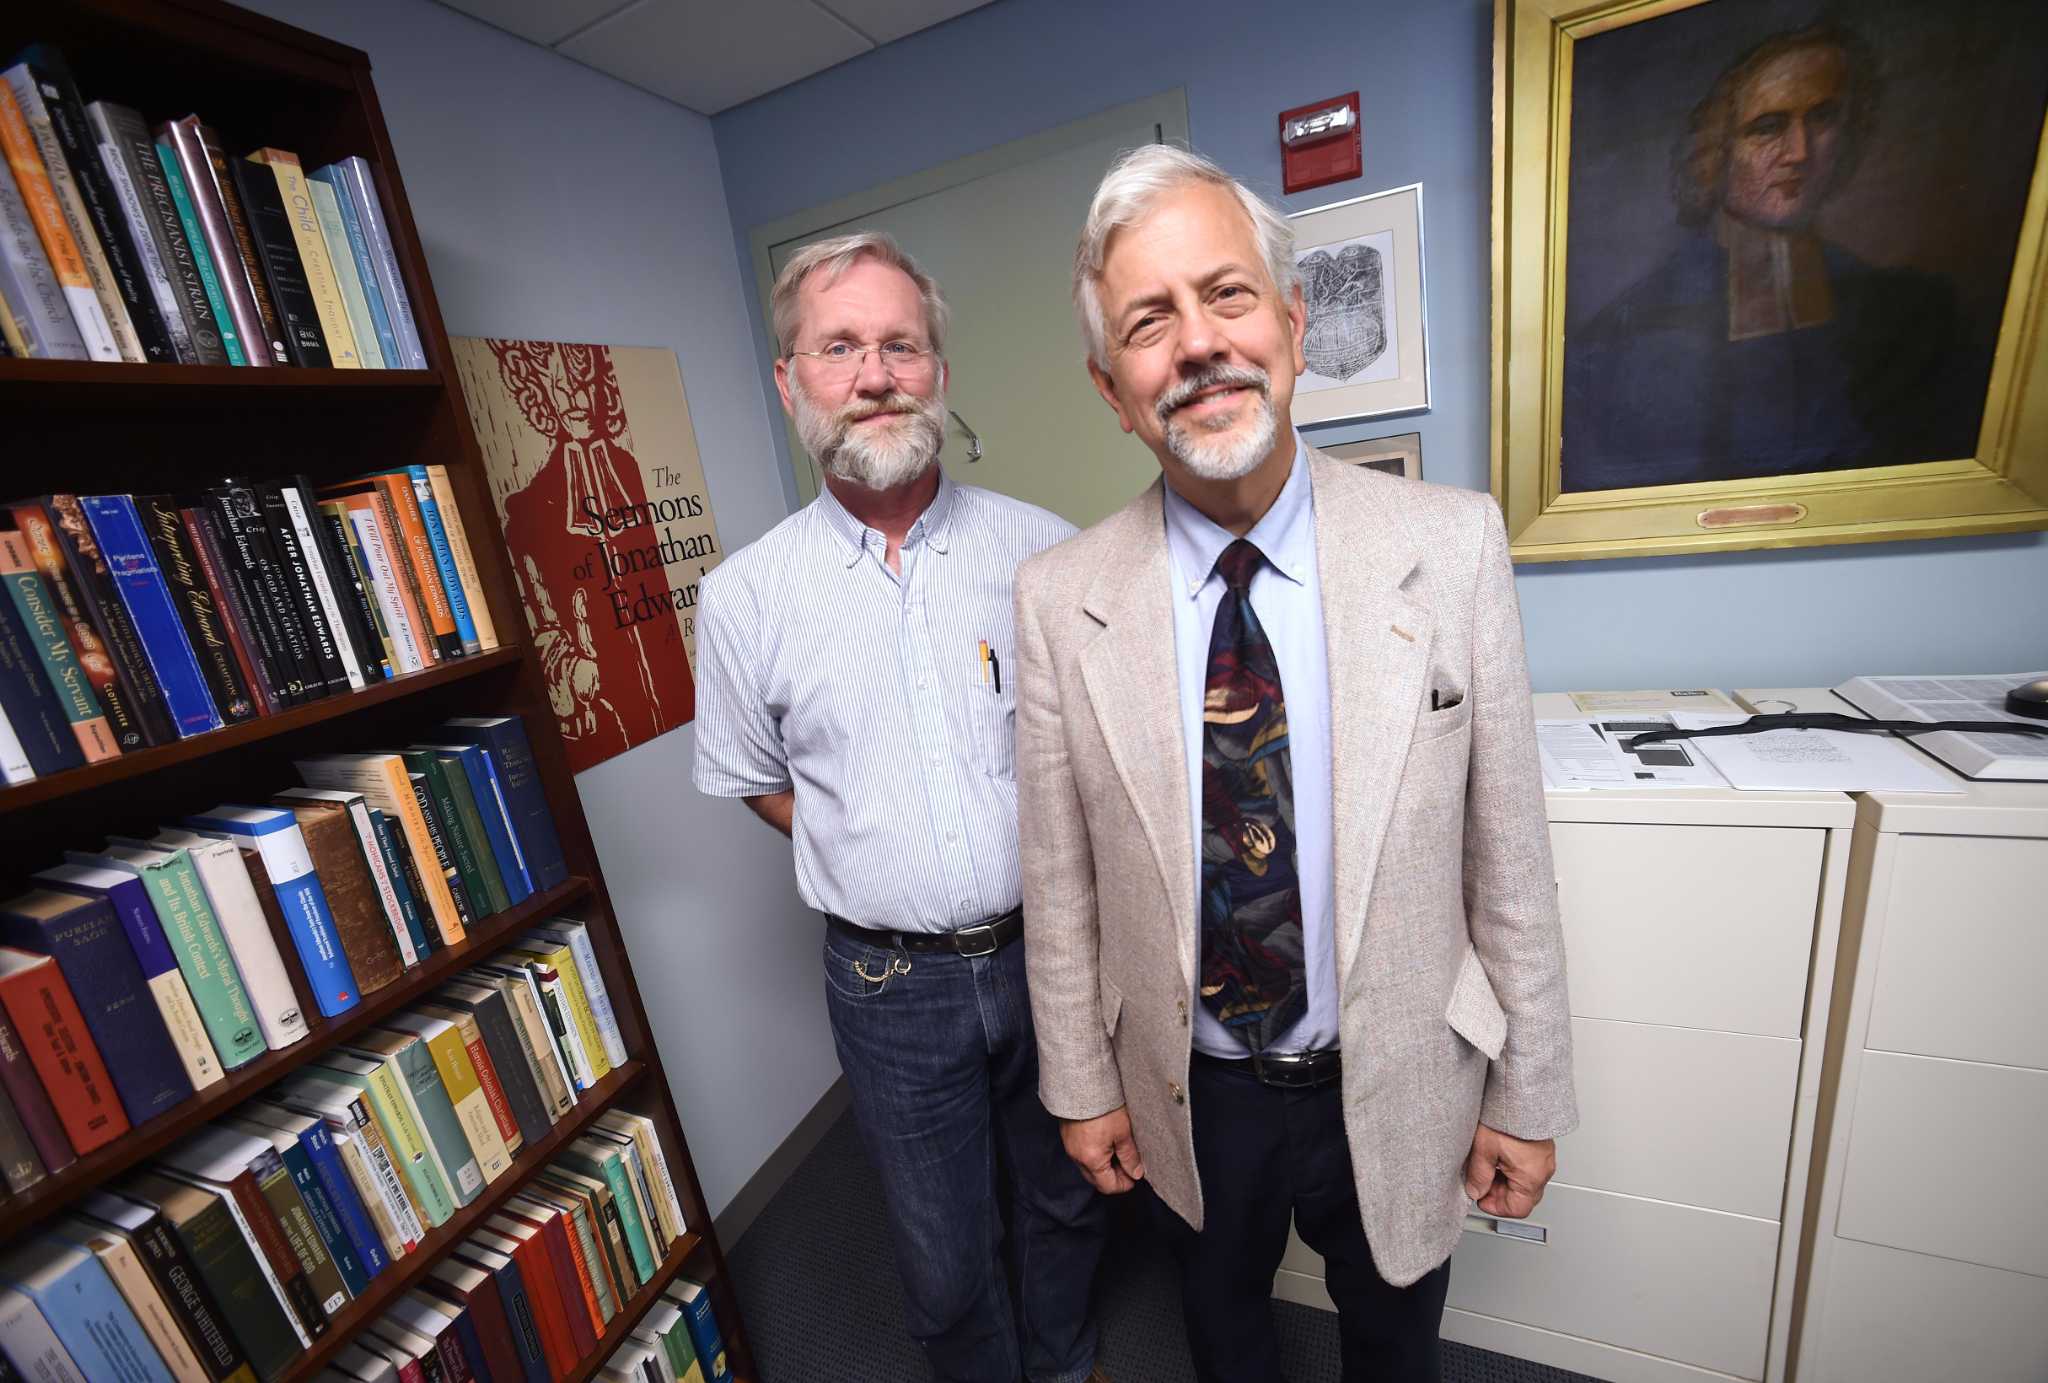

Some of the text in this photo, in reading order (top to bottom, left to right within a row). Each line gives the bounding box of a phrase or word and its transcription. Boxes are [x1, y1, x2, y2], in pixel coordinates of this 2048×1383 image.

[134, 137, 158, 174] THE
[180, 266, 213, 324] STRAIN
[292, 194, 316, 233] Child
[652, 465, 681, 488] The
[217, 495, 240, 534] Jonathan
[236, 535, 256, 570] Edwards
[365, 523, 379, 542] Will
[583, 494, 704, 536] Sermons
[371, 542, 386, 563] Pour
[379, 563, 392, 580] Out
[425, 508, 451, 567] JONATHAN
[442, 567, 468, 621] EDWARDS
[573, 526, 717, 591] of Jonathan
[186, 590, 225, 648] Edwards
[259, 558, 304, 660] ON GOD AND CREATION
[280, 527, 298, 559] AFTER
[292, 560, 318, 613] JONATHAN
[311, 614, 335, 661] EDWARDS
[383, 579, 397, 597] My
[389, 594, 406, 620] Spirit
[608, 566, 706, 630] Edwar
[19, 576, 56, 638] Consider
[48, 641, 70, 662] My
[60, 666, 92, 716] Servant
[414, 785, 450, 868] GOD AND HIS PEOPLE
[159, 878, 210, 980] and Its British Context
[177, 869, 250, 1025] Jonathan Edwards's Moral Thought
[168, 1264, 234, 1367] GEORGE WHITEFIELD
